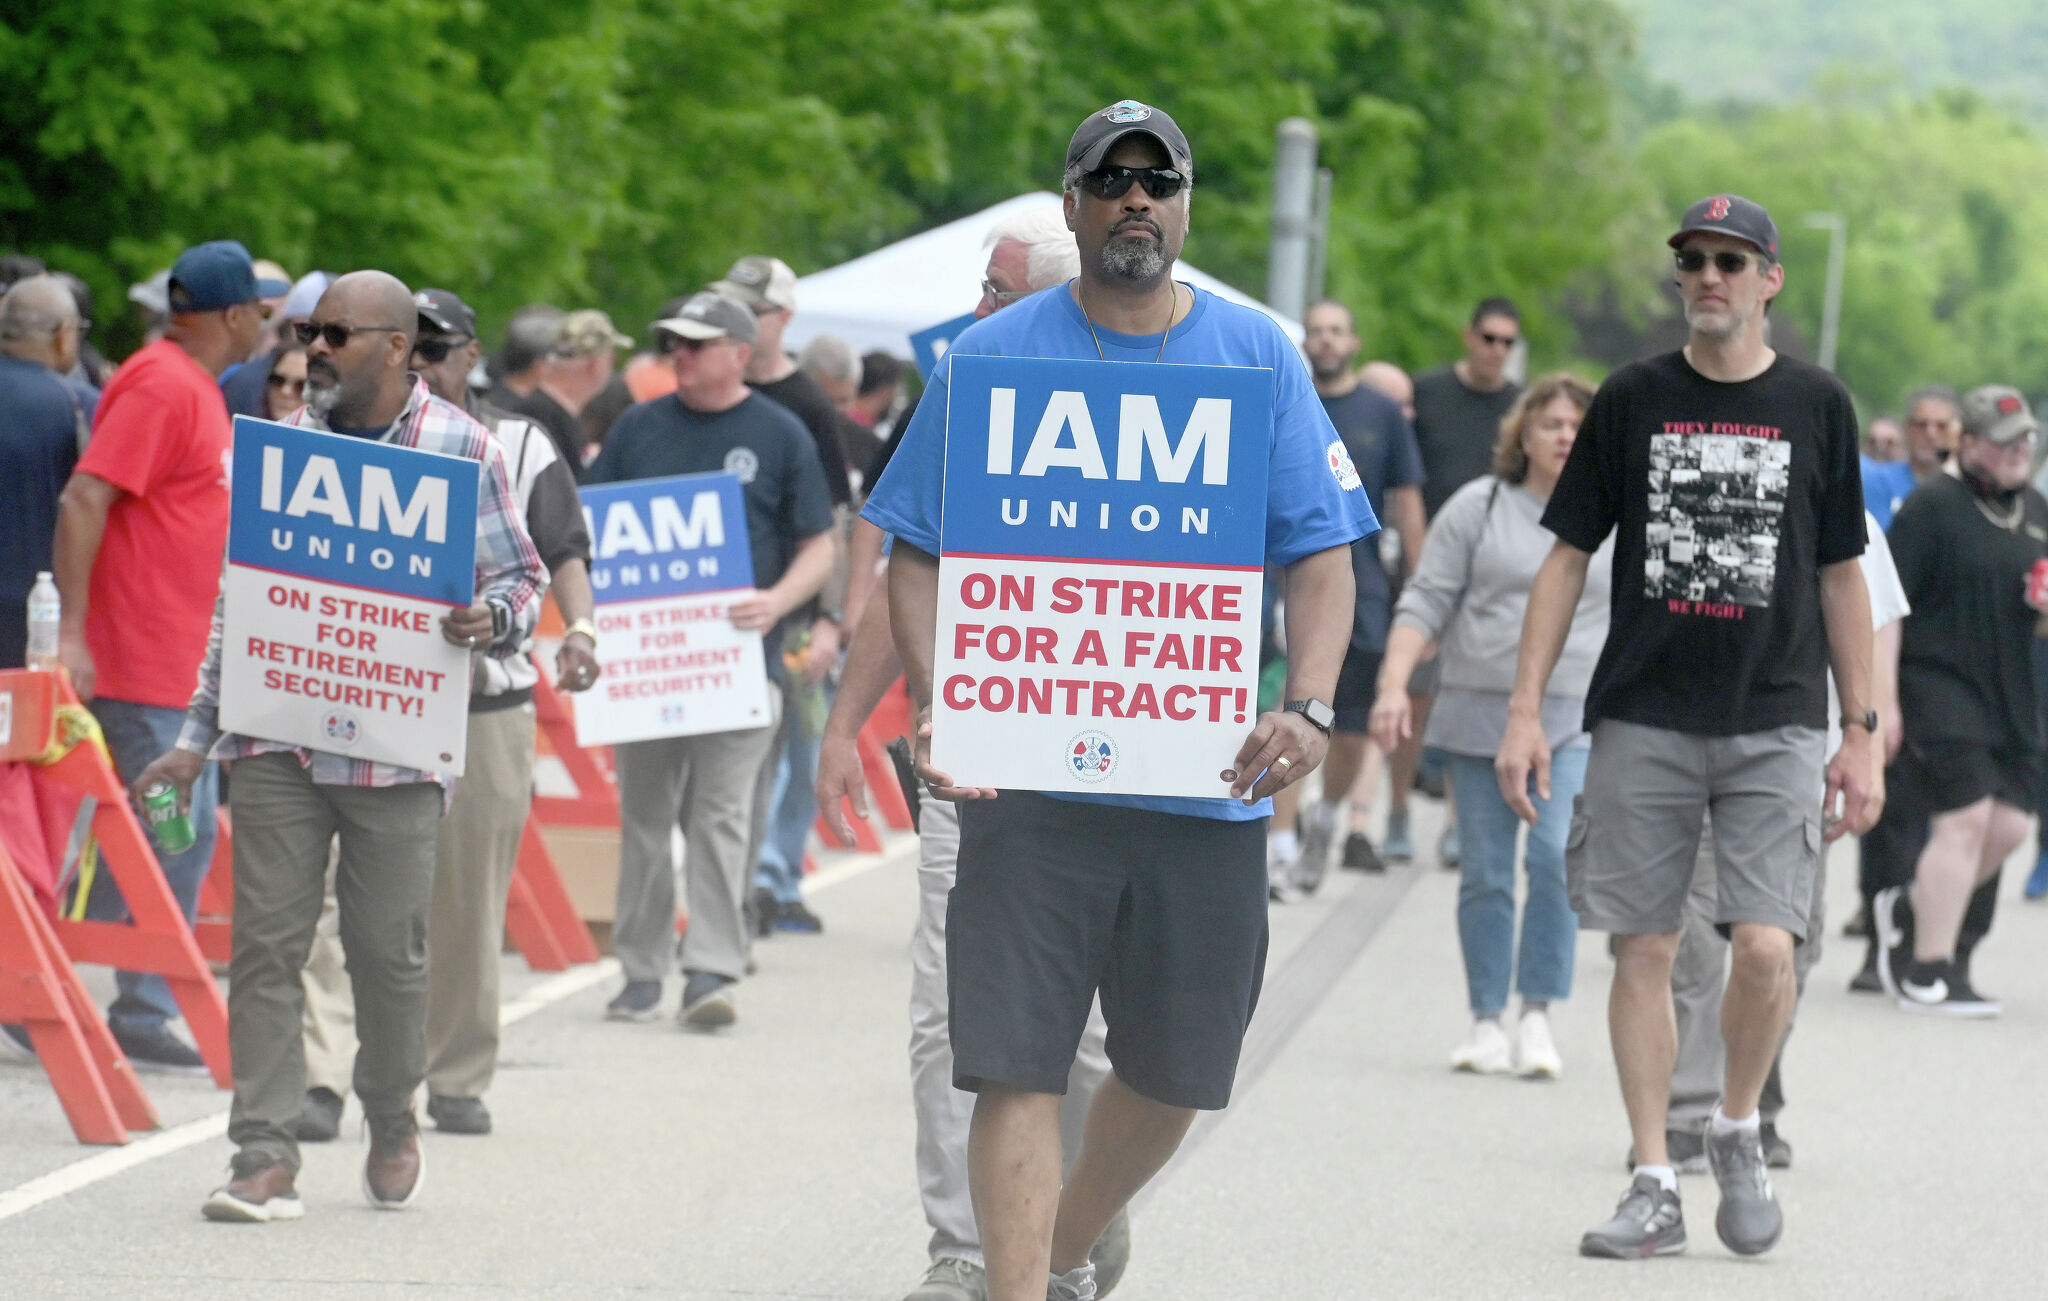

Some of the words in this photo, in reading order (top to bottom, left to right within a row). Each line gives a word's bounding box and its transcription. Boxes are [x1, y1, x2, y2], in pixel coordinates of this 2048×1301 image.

[1704, 196, 1731, 220] B
[986, 387, 1232, 486] IAM
[1663, 421, 1706, 435] THEY
[1712, 422, 1782, 439] FOUGHT
[260, 445, 449, 544] IAM
[1001, 498, 1209, 535] UNION
[271, 528, 432, 578] UNION
[591, 557, 719, 589] UNION
[268, 585, 310, 611] ON
[319, 596, 431, 633] STRIKE
[960, 573, 1035, 612] ON
[1049, 577, 1242, 622] STRIKE
[1668, 599, 1690, 614] WE
[1695, 601, 1745, 619] FIGHT
[598, 614, 631, 632] ON
[639, 604, 722, 627] STRIKE
[316, 623, 377, 651] FOR
[640, 631, 687, 649] FOR
[953, 623, 1059, 664] FOR
[1071, 629, 1108, 667] A
[1124, 631, 1243, 673] FAIR
[247, 637, 446, 692] RETIREMENT
[600, 646, 742, 678] ETIREMENT
[264, 670, 425, 717] SECURITY!
[607, 672, 732, 700] SECURITY!
[942, 674, 1248, 724] CONTRACT!
